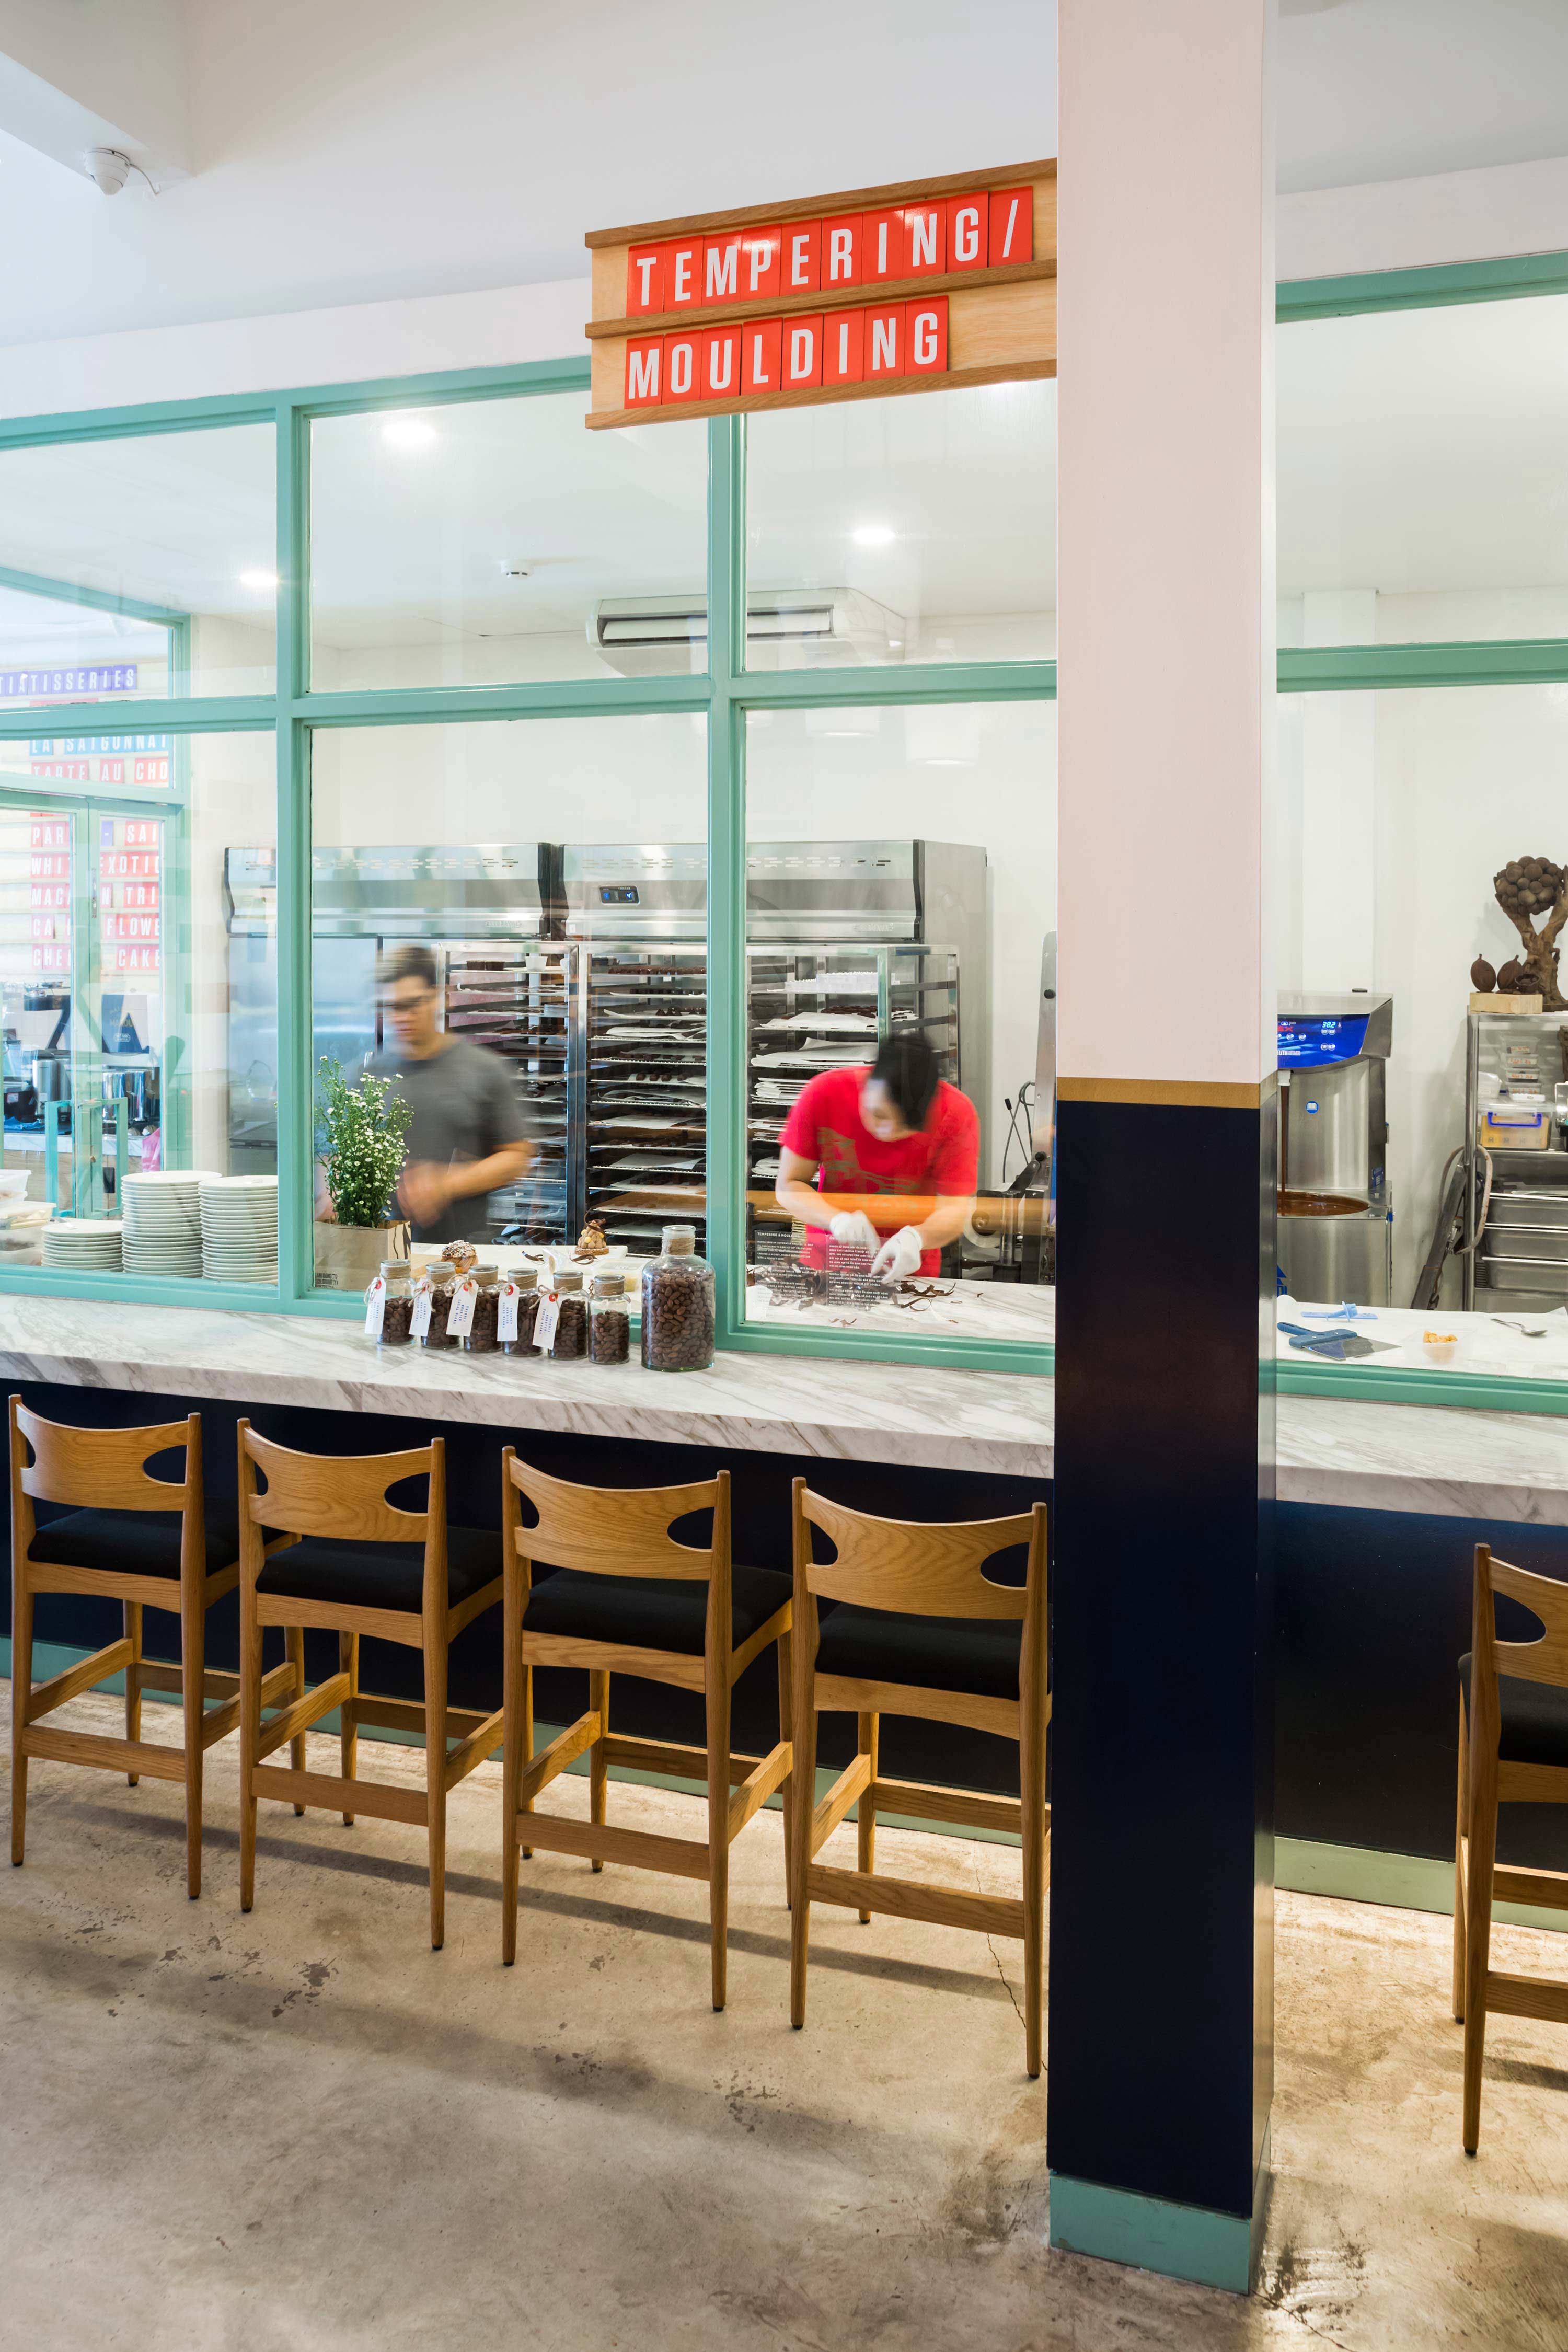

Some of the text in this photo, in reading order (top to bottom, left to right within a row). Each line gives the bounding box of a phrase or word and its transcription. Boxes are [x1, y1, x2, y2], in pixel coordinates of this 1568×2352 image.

[637, 199, 1019, 306] TEMPERING/
[628, 312, 938, 399] MOULDING
[32, 739, 50, 753] LA
[101, 763, 122, 781] AU
[136, 762, 168, 780] CHO
[31, 857, 70, 875] WHI
